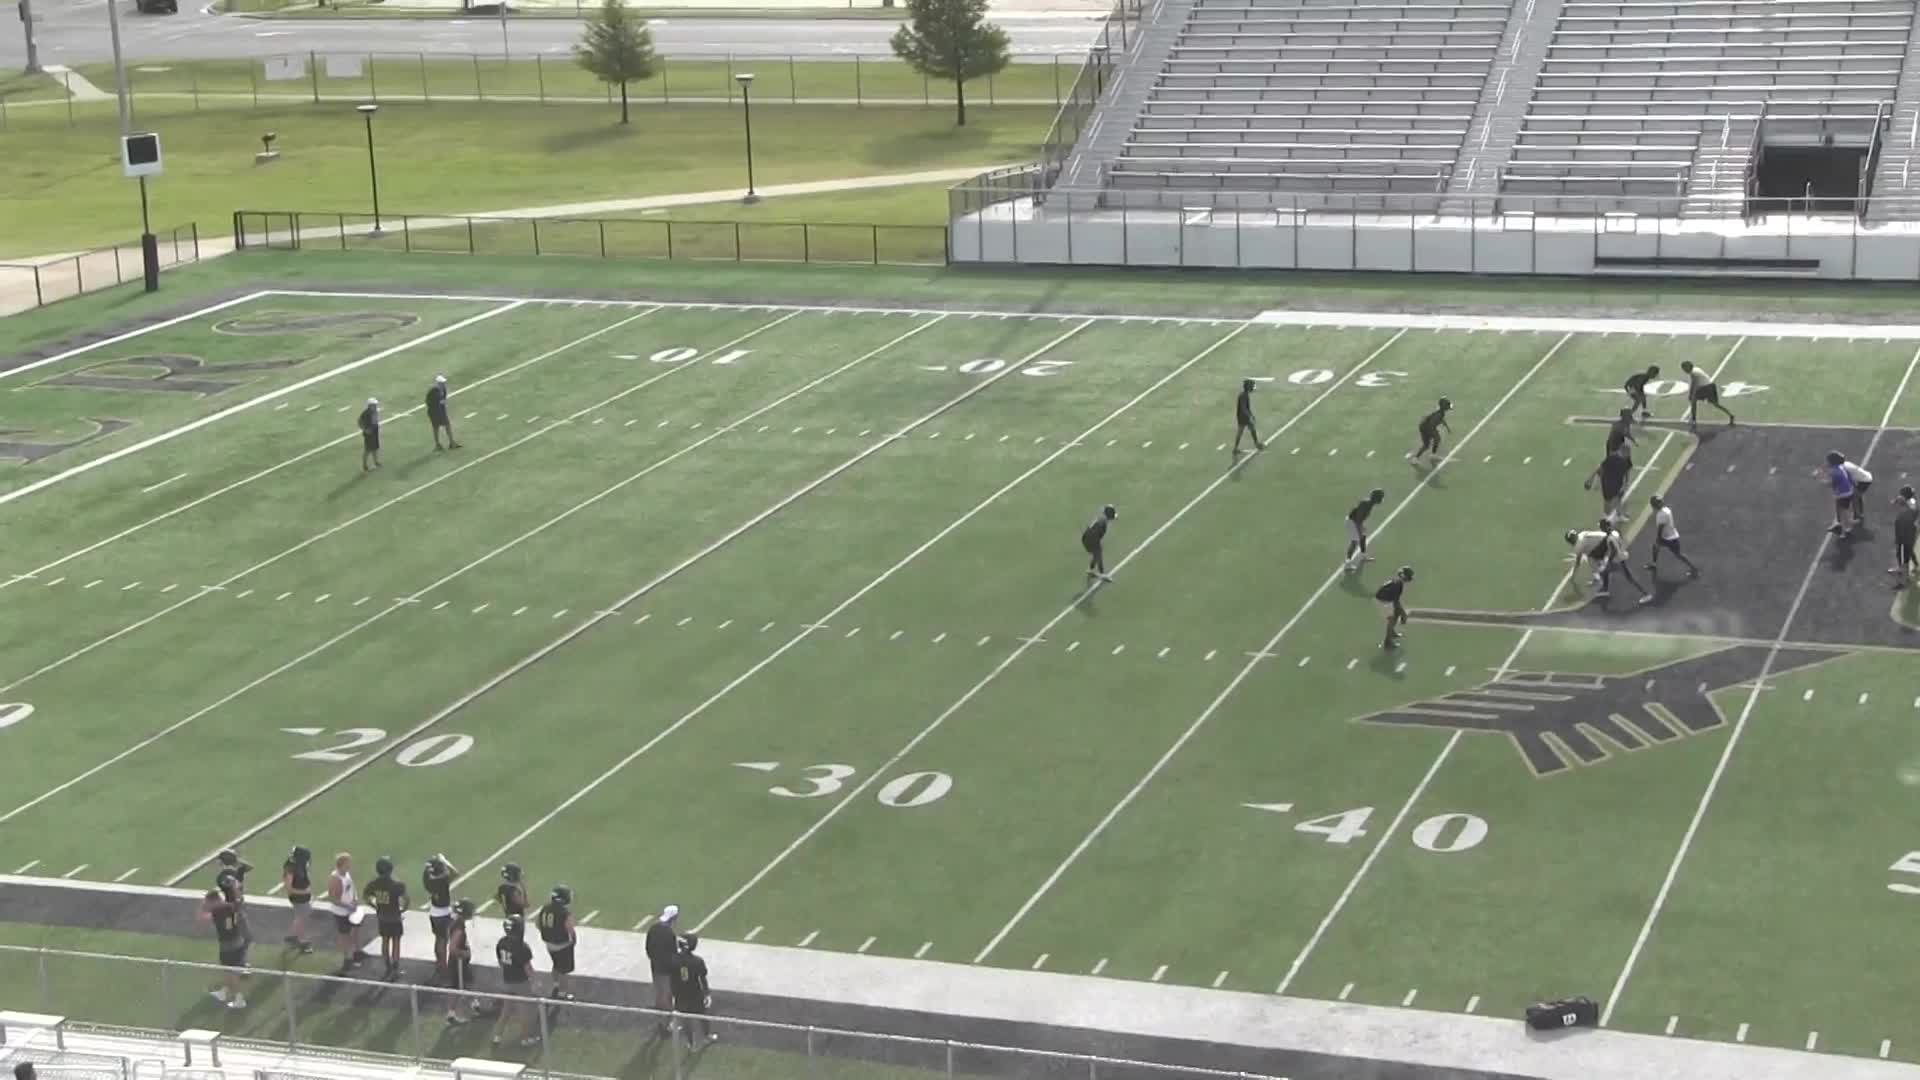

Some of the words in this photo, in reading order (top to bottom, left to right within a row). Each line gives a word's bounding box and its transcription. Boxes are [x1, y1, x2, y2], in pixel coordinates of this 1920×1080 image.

[650, 347, 757, 364] 10
[959, 358, 1079, 377] 20
[1287, 369, 1409, 387] 30
[1643, 380, 1770, 398] 40
[290, 727, 474, 767] 20
[768, 763, 953, 807] 30
[1294, 806, 1489, 852] 40
